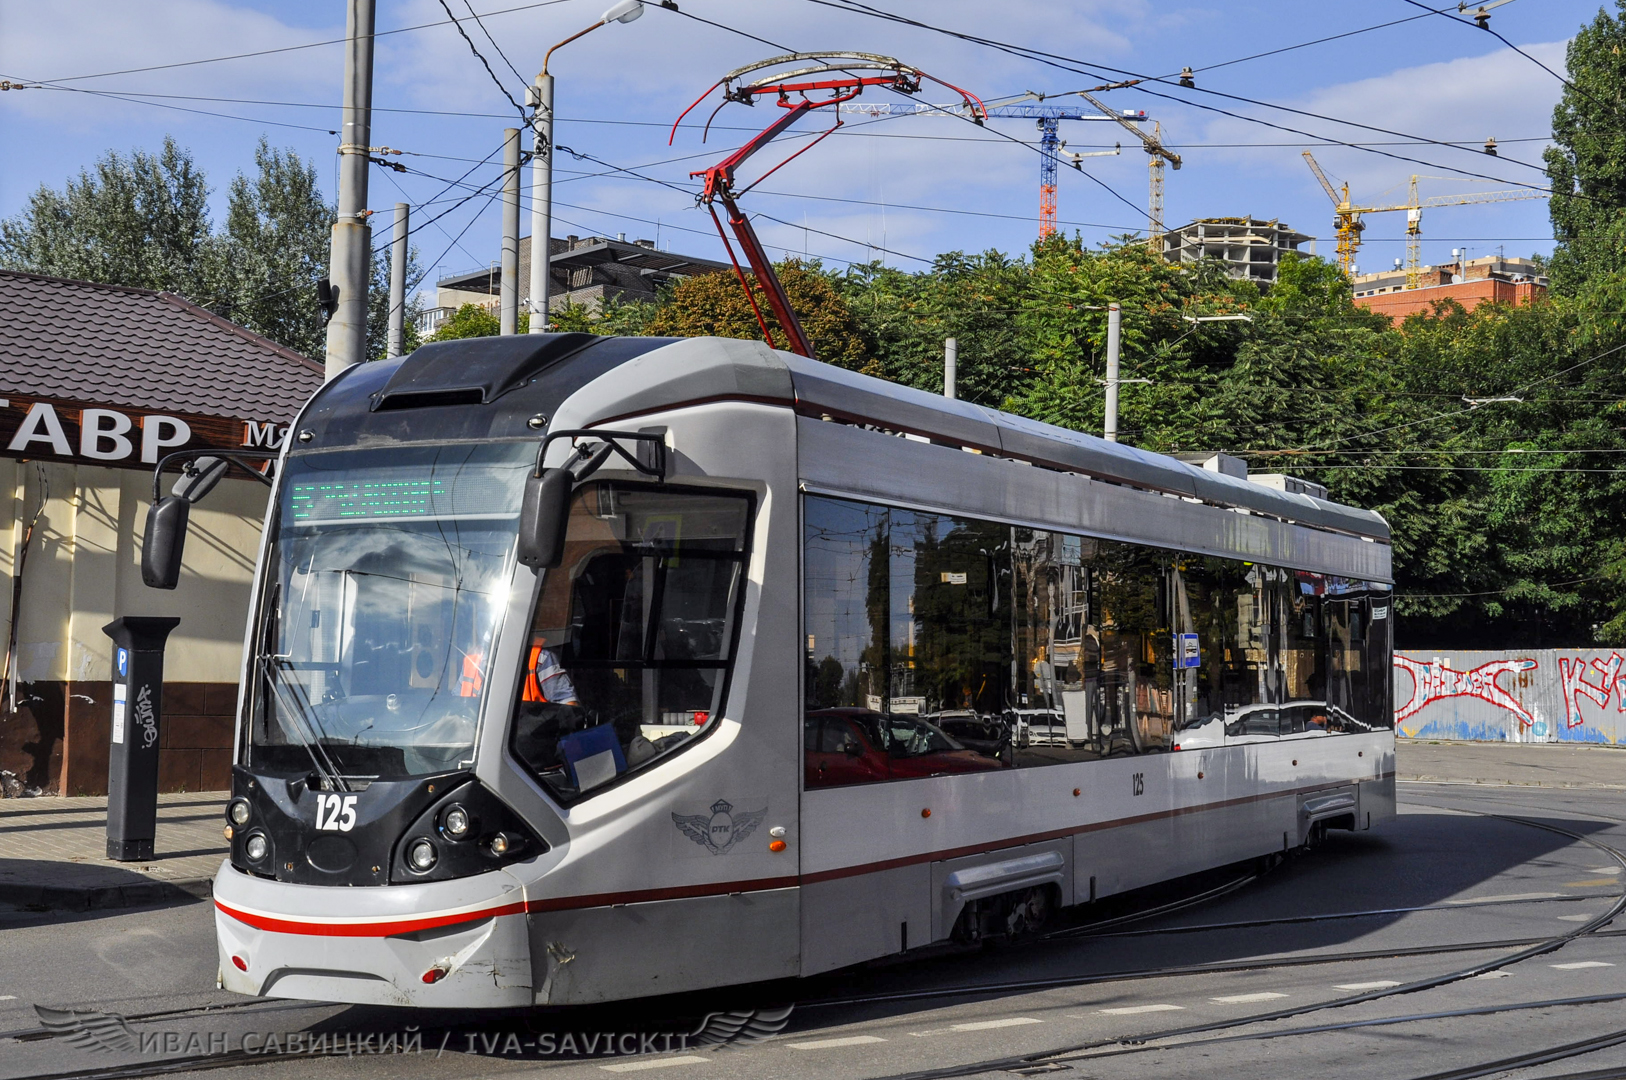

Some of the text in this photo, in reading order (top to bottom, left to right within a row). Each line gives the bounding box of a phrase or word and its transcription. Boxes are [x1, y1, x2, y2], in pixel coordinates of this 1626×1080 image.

[0, 399, 191, 464] АВР
[1132, 772, 1144, 797] 125
[315, 794, 358, 832] 125
